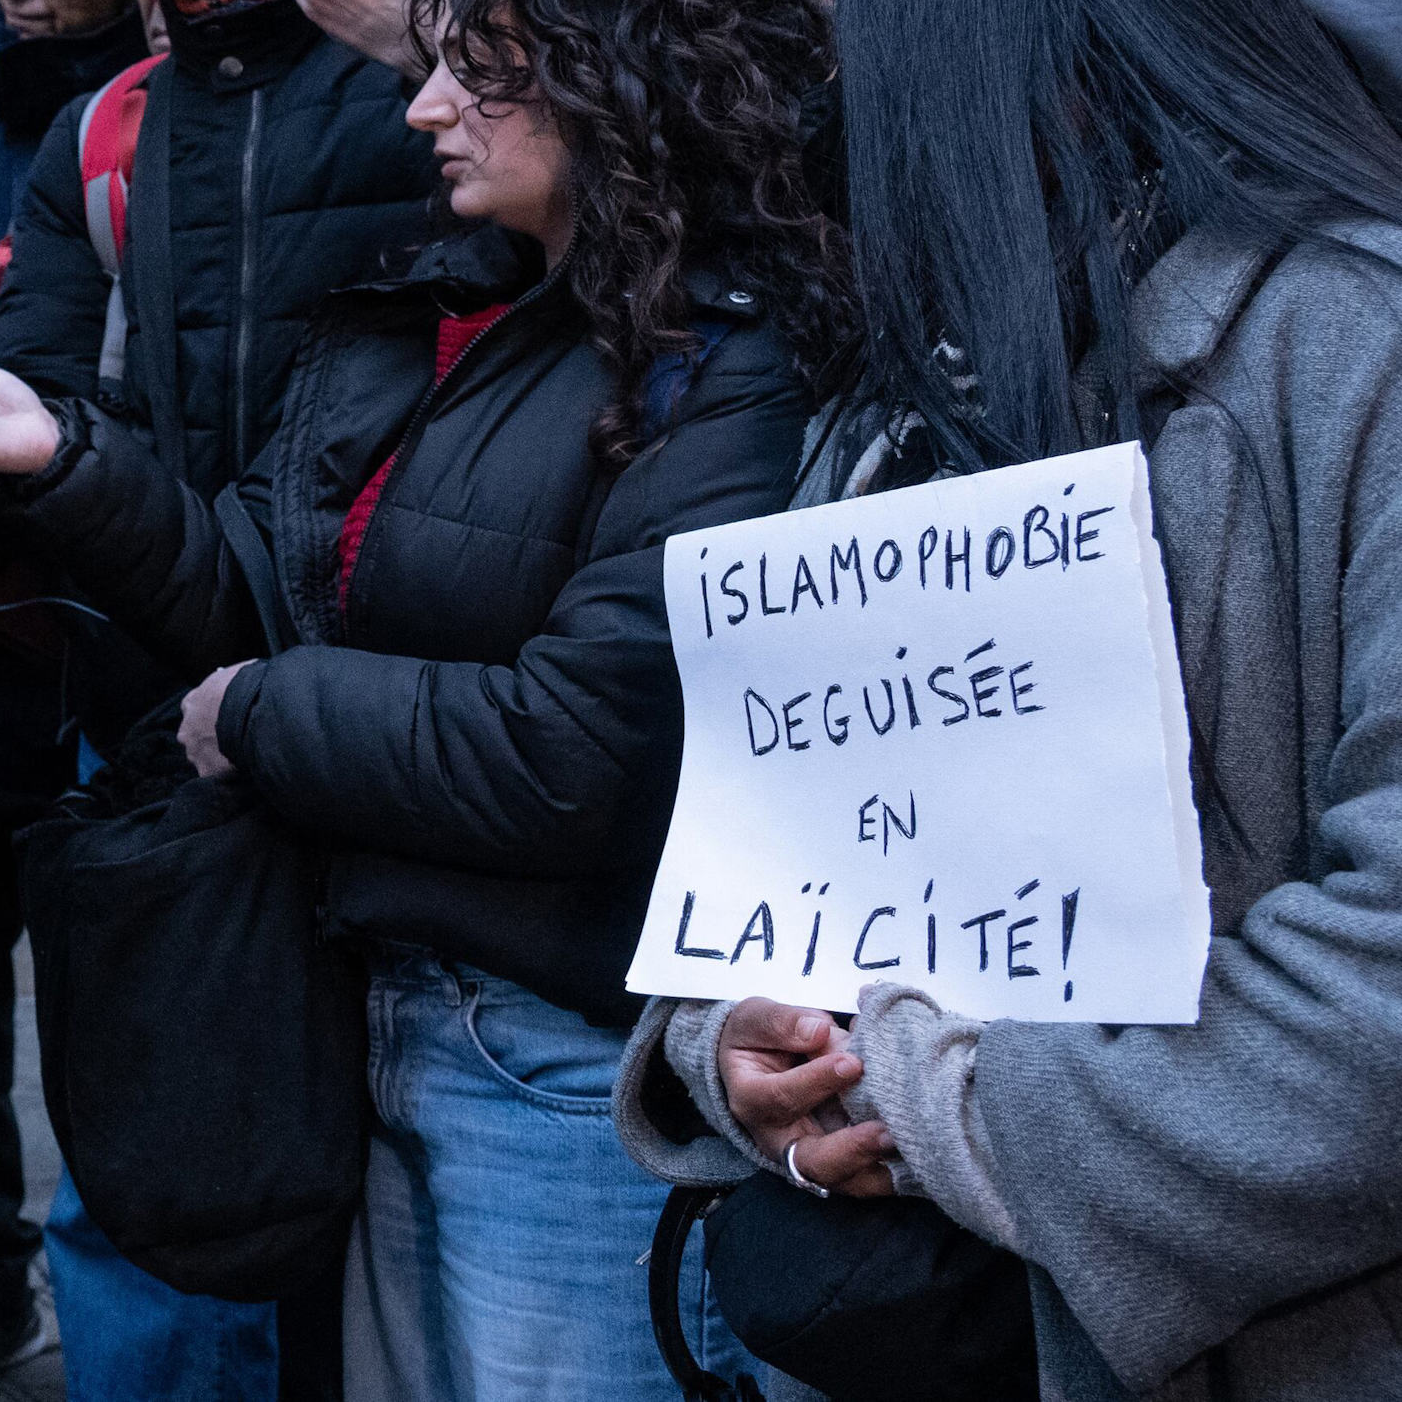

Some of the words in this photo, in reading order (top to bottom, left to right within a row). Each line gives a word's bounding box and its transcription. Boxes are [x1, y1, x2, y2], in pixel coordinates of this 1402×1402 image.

[699, 482, 1115, 638] ISLAMOPHOBIE
[743, 638, 1046, 757] DEGUISÉE
[858, 789, 917, 856] EN
[674, 878, 1081, 1002] LAÏCITÉ!
